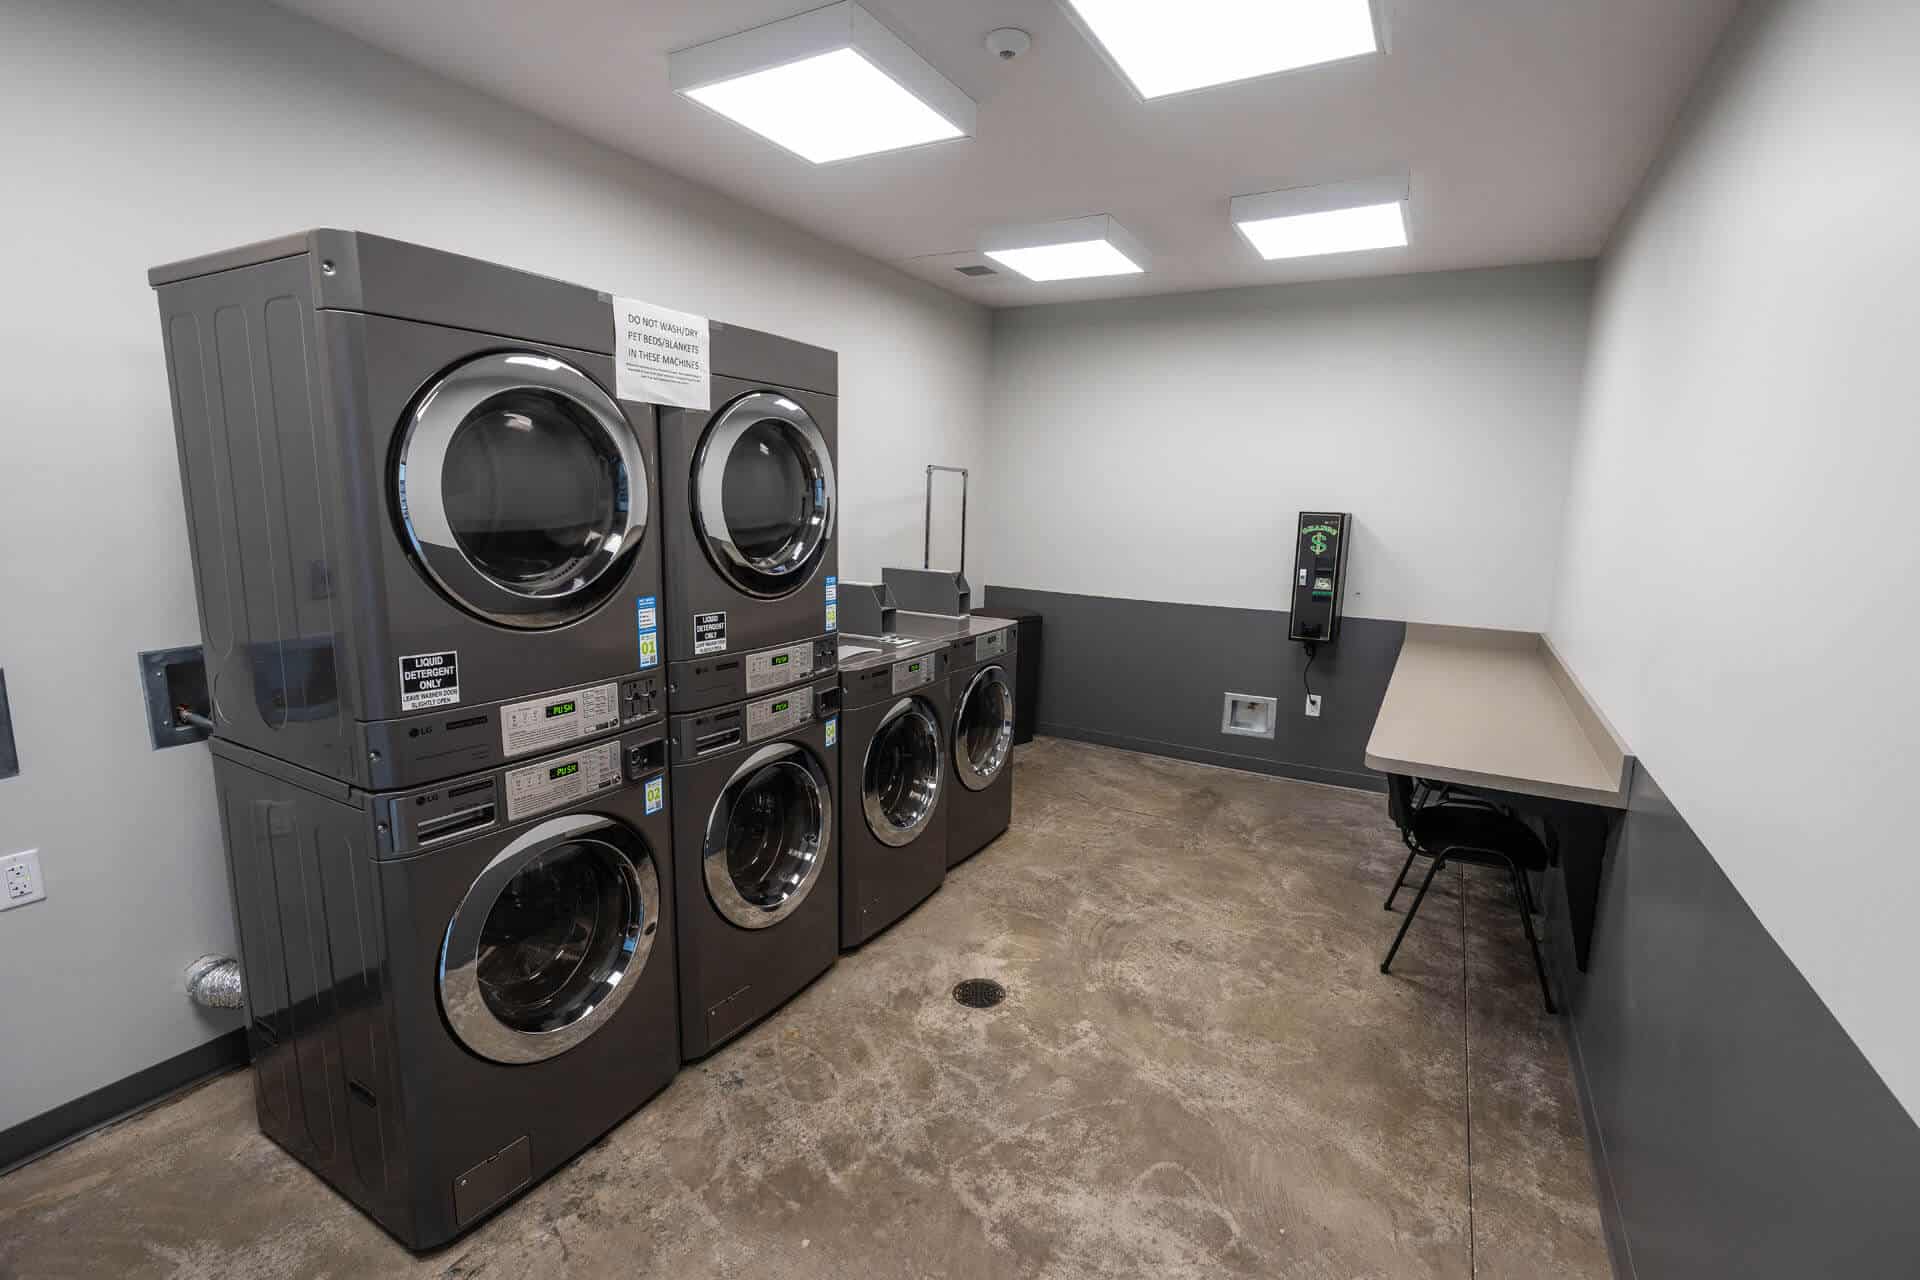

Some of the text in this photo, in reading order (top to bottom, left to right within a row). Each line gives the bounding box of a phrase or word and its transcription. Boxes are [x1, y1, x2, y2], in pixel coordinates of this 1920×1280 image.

[628, 313, 698, 339] DO NOT WASH/DRY
[628, 331, 699, 354] PET BEDS/BLANKETS
[628, 348, 700, 370] IN THESE MACHINES
[641, 640, 656, 655] 01
[415, 656, 443, 667] LIQUID
[404, 666, 455, 680] DETERGENT
[419, 678, 443, 690] ONLY
[553, 702, 574, 715] PUSH
[556, 763, 577, 777] PUSH
[647, 785, 661, 802] 02
